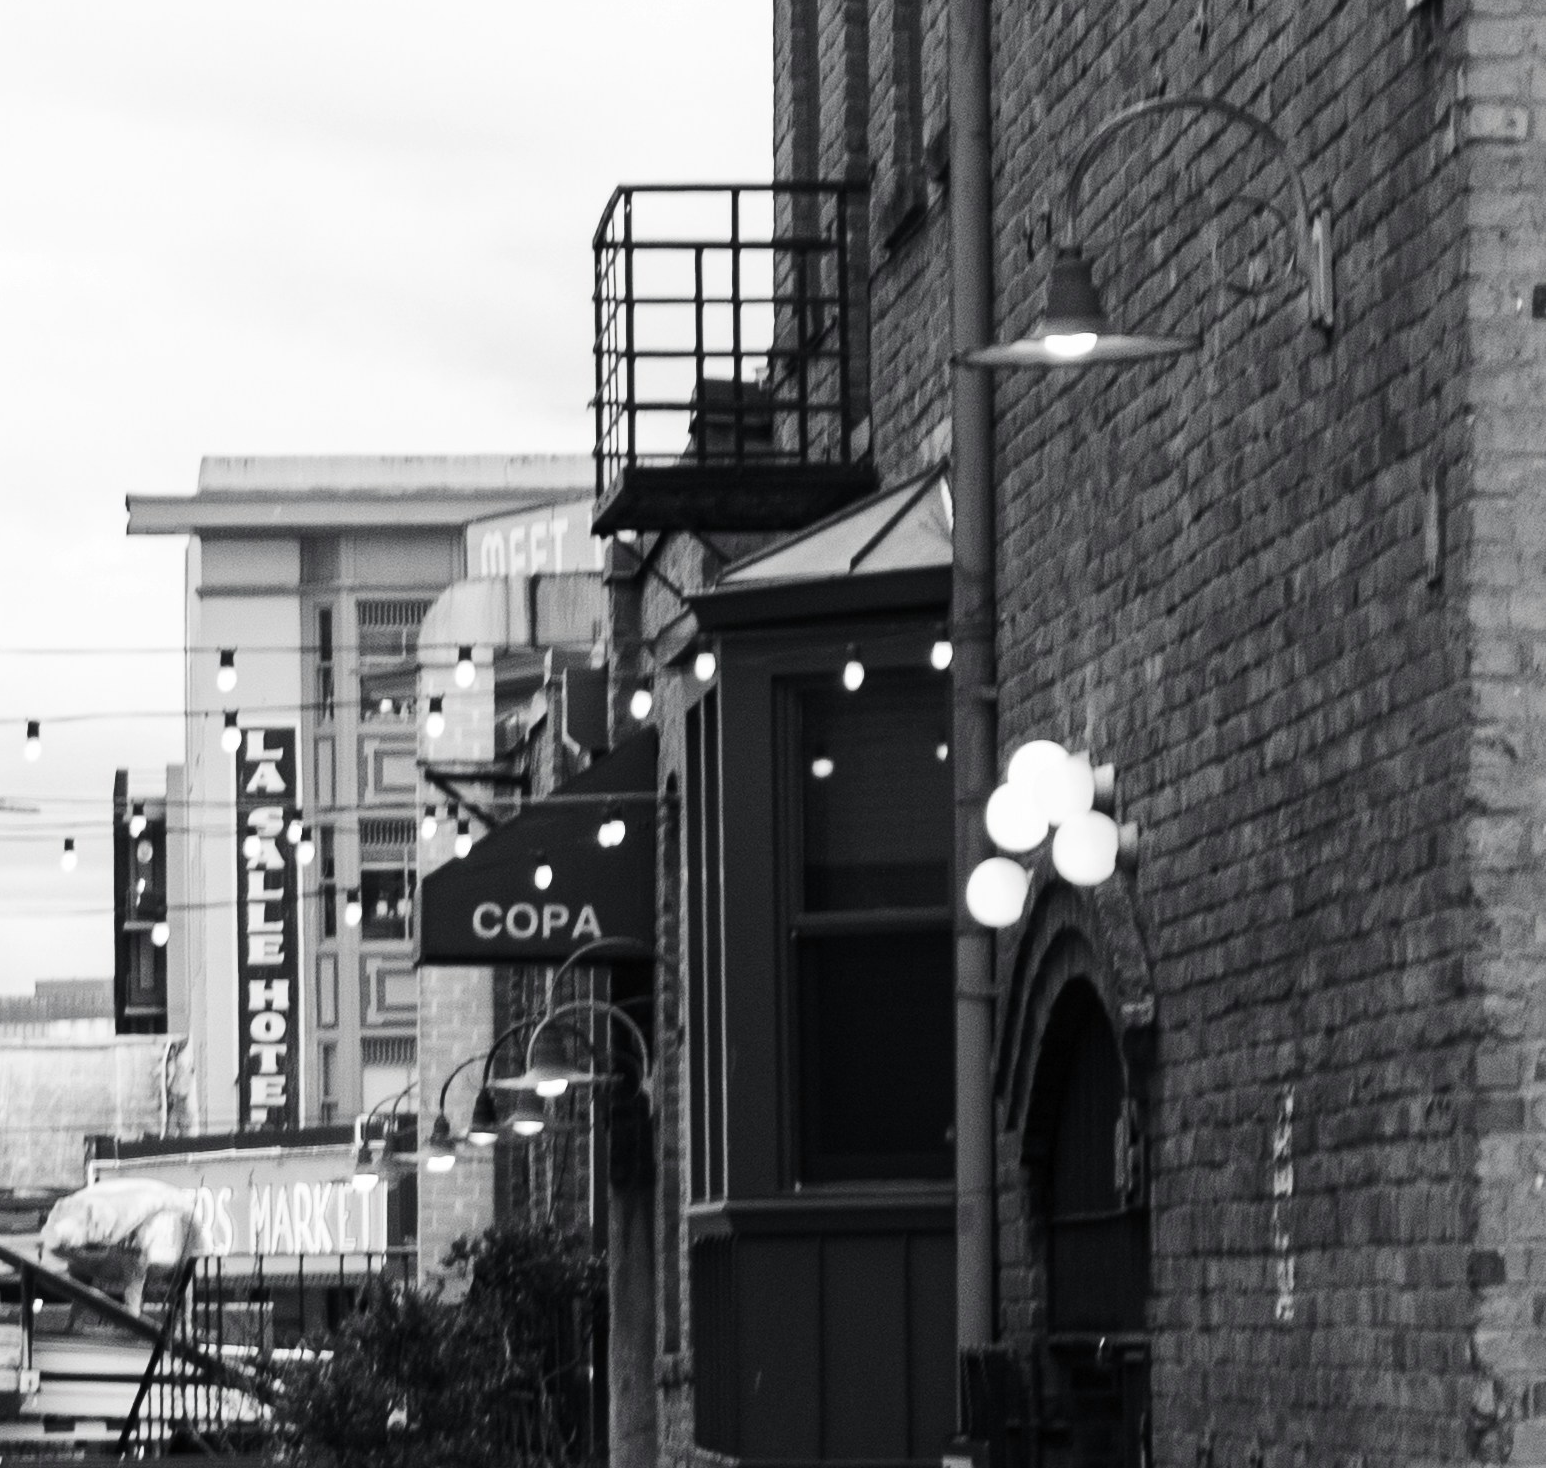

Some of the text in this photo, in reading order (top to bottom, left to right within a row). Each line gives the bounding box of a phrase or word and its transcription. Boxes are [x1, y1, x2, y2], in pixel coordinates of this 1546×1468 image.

[245, 728, 287, 794] LA
[245, 805, 286, 965] SALLE
[472, 901, 602, 939] COPA
[250, 1181, 379, 1256] MARKET
